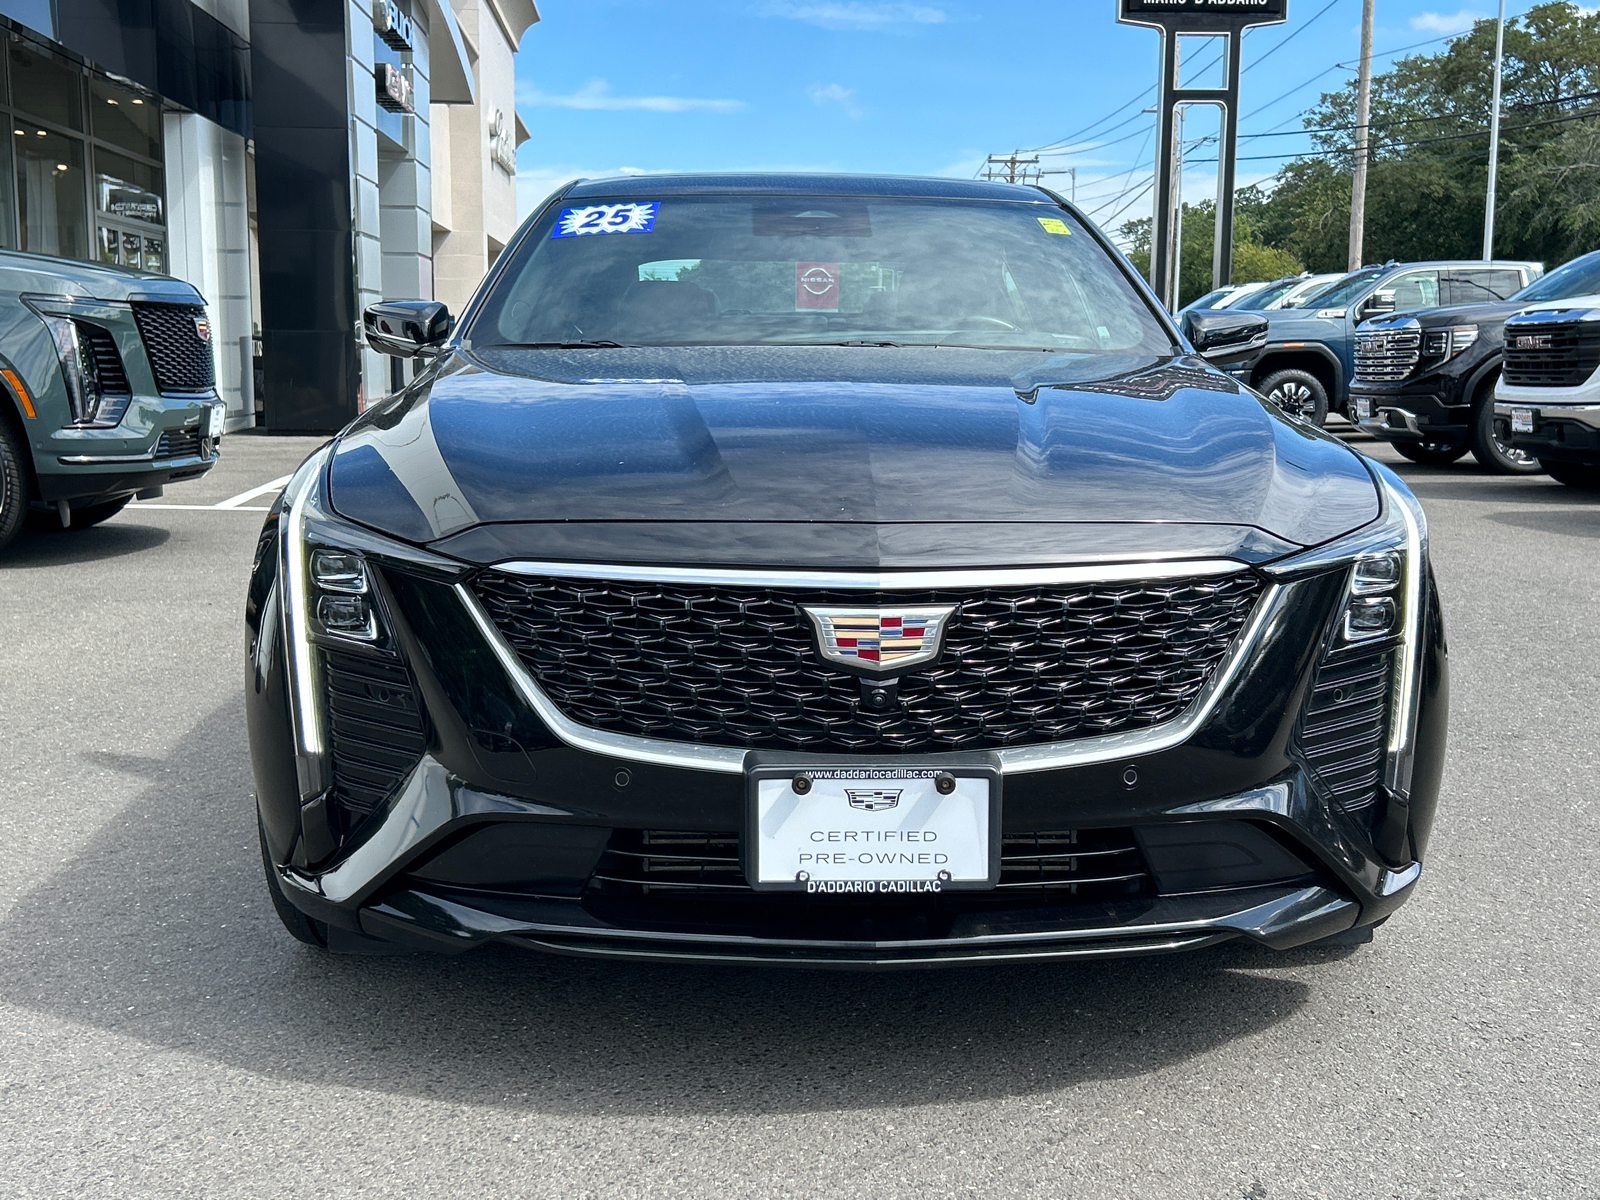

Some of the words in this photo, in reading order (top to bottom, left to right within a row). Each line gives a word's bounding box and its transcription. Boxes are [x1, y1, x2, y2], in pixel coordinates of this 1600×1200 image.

[578, 208, 632, 228] 25
[1515, 335, 1551, 349] GMC
[805, 769, 943, 779] www.daddariocadillac.com
[810, 831, 938, 842] CERTIFIED
[799, 853, 949, 864] PRE-OWNED
[807, 880, 876, 893] D'ADDARIO
[879, 880, 941, 892] CADILLAC
